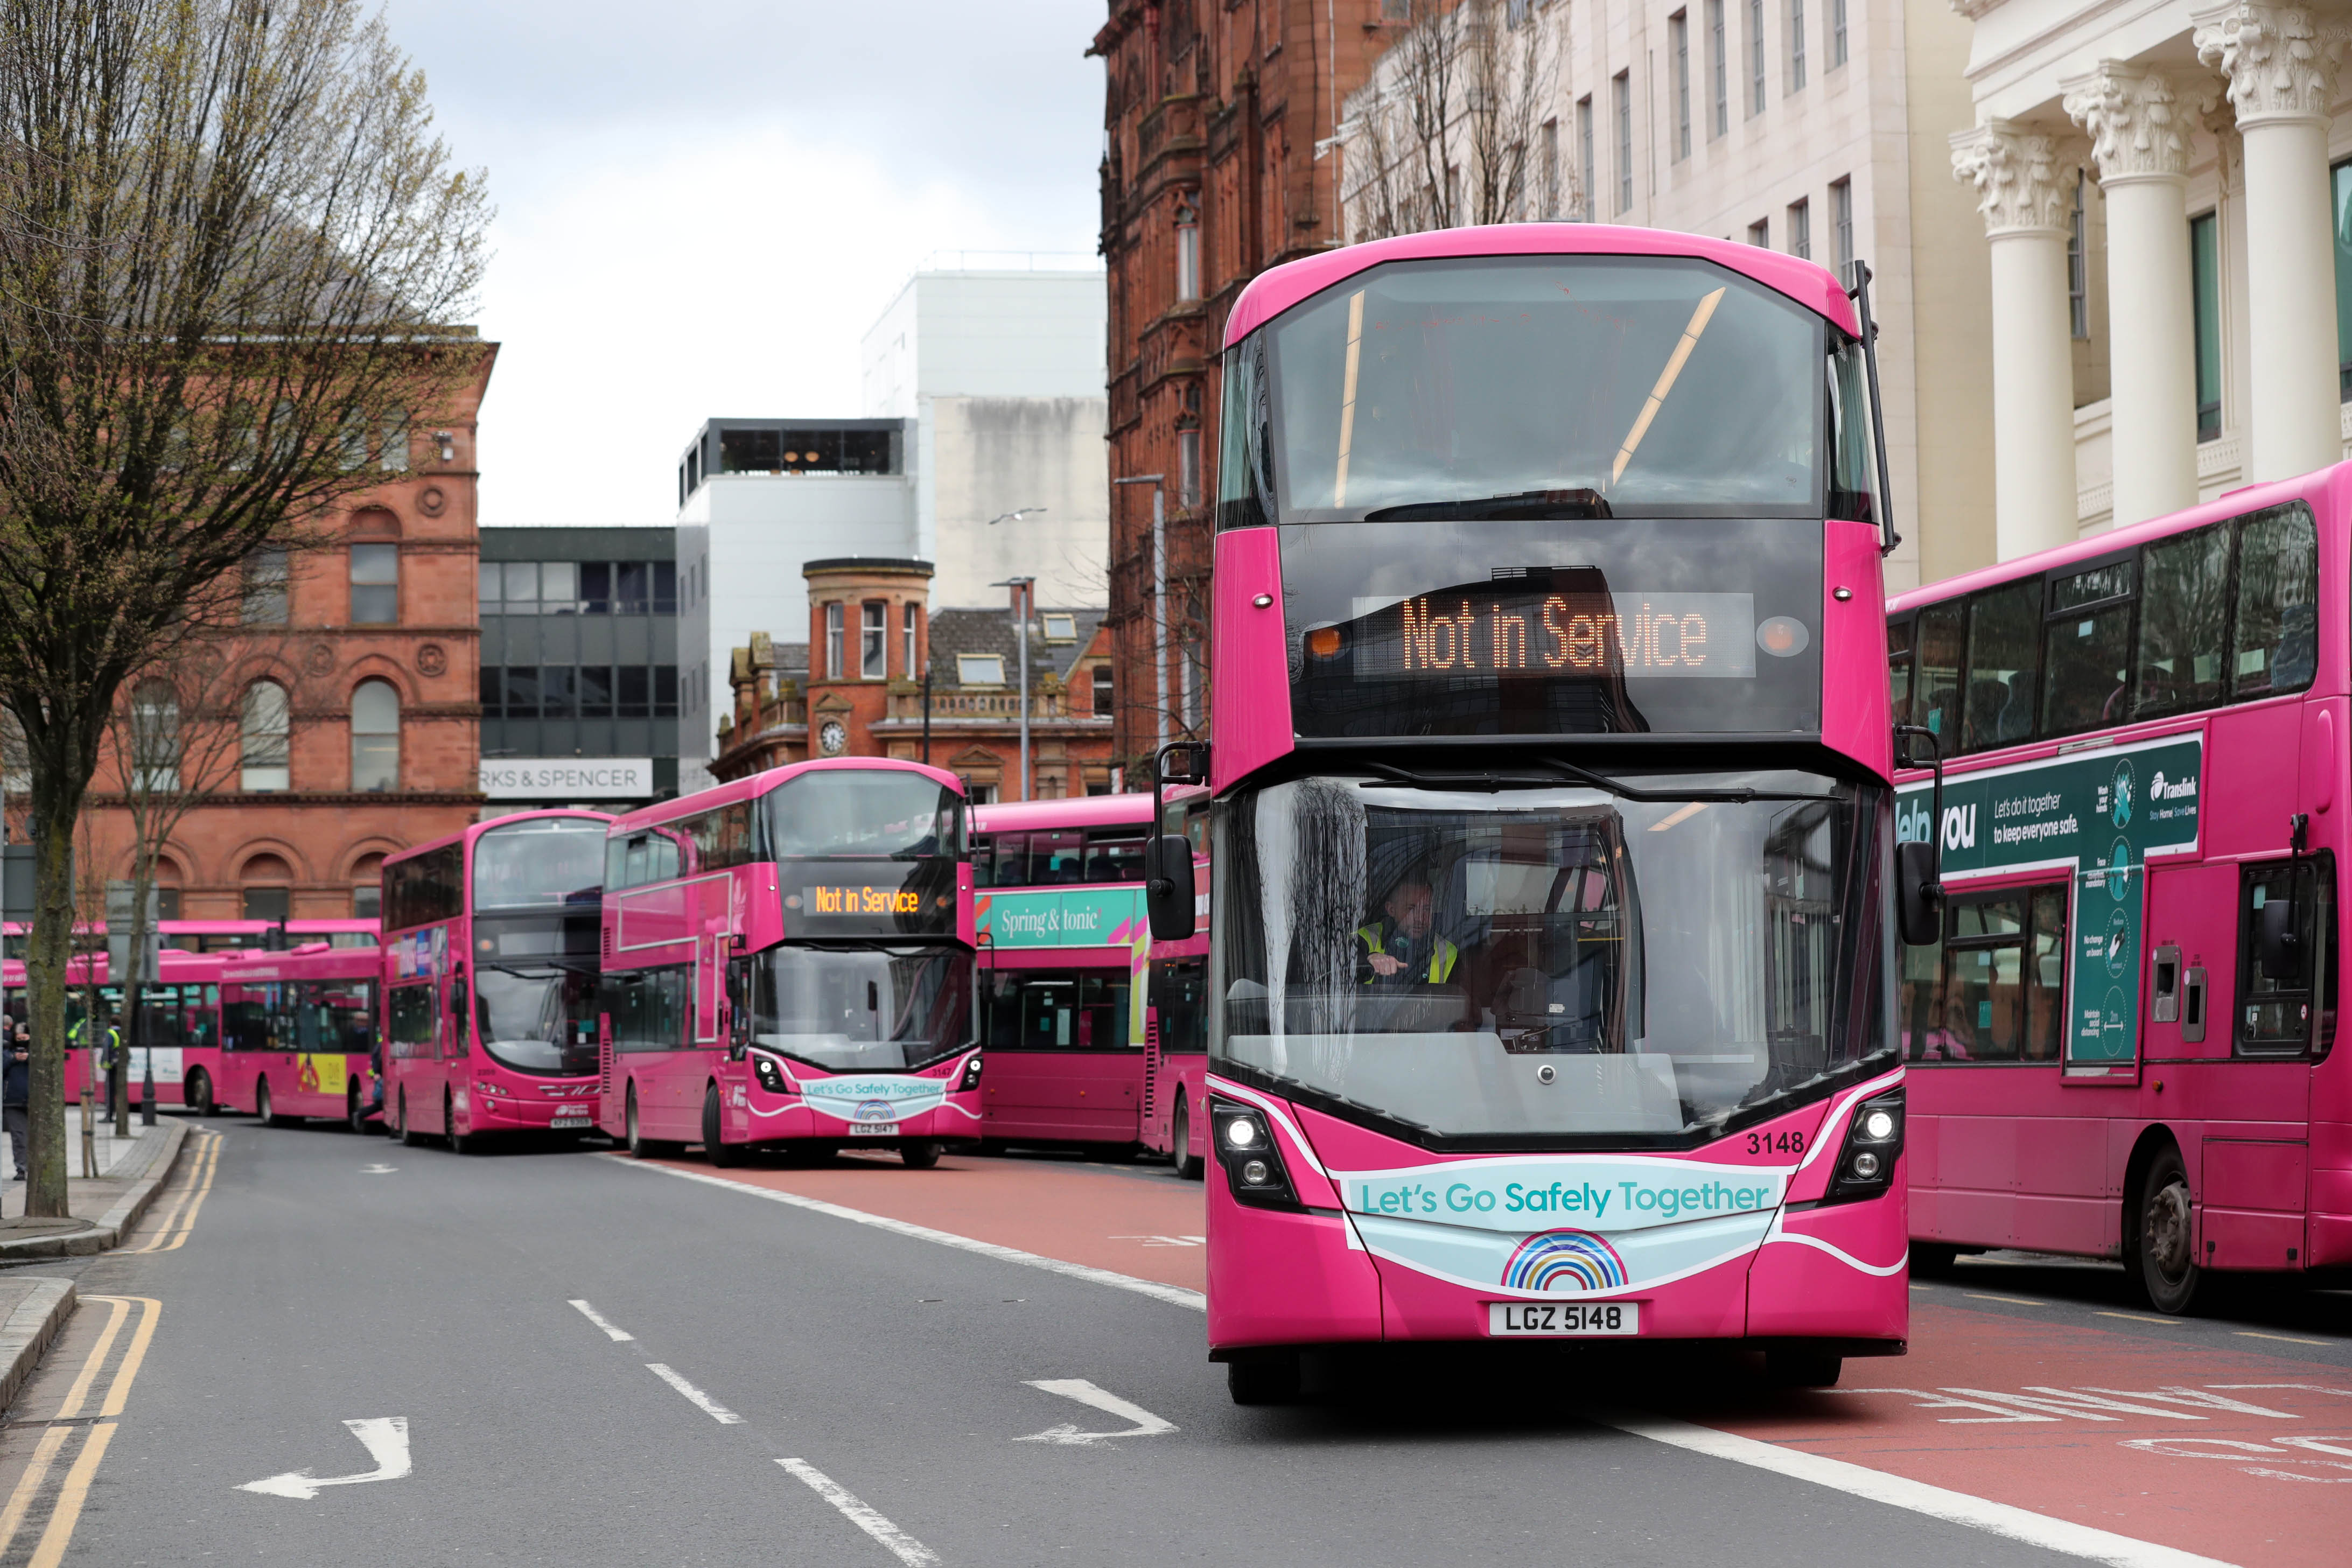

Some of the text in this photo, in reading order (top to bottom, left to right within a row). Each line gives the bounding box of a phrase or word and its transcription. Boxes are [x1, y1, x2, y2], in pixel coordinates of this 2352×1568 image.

[1404, 597, 1706, 669] Not in Service
[479, 769, 638, 787] RKS & SPENCER
[2162, 776, 2196, 800] Translink
[1994, 791, 2061, 818] Let's do it together
[2174, 807, 2185, 817] Save
[2185, 805, 2196, 816] Lives
[1994, 813, 2078, 845] to keep everyone safe.
[816, 886, 919, 912] Not in Service
[1002, 908, 1047, 939] Spring
[1048, 908, 1060, 930] &
[2091, 947, 2103, 957] board
[933, 1068, 951, 1076] 3147
[807, 1083, 941, 1096] Let's Go Safely Together
[855, 1125, 893, 1133] LGZ 5147
[1747, 1131, 1804, 1155] 3148
[1363, 1181, 1769, 1218] Let's Go Safely Together
[1506, 1306, 1621, 1330] LGZ 5148
